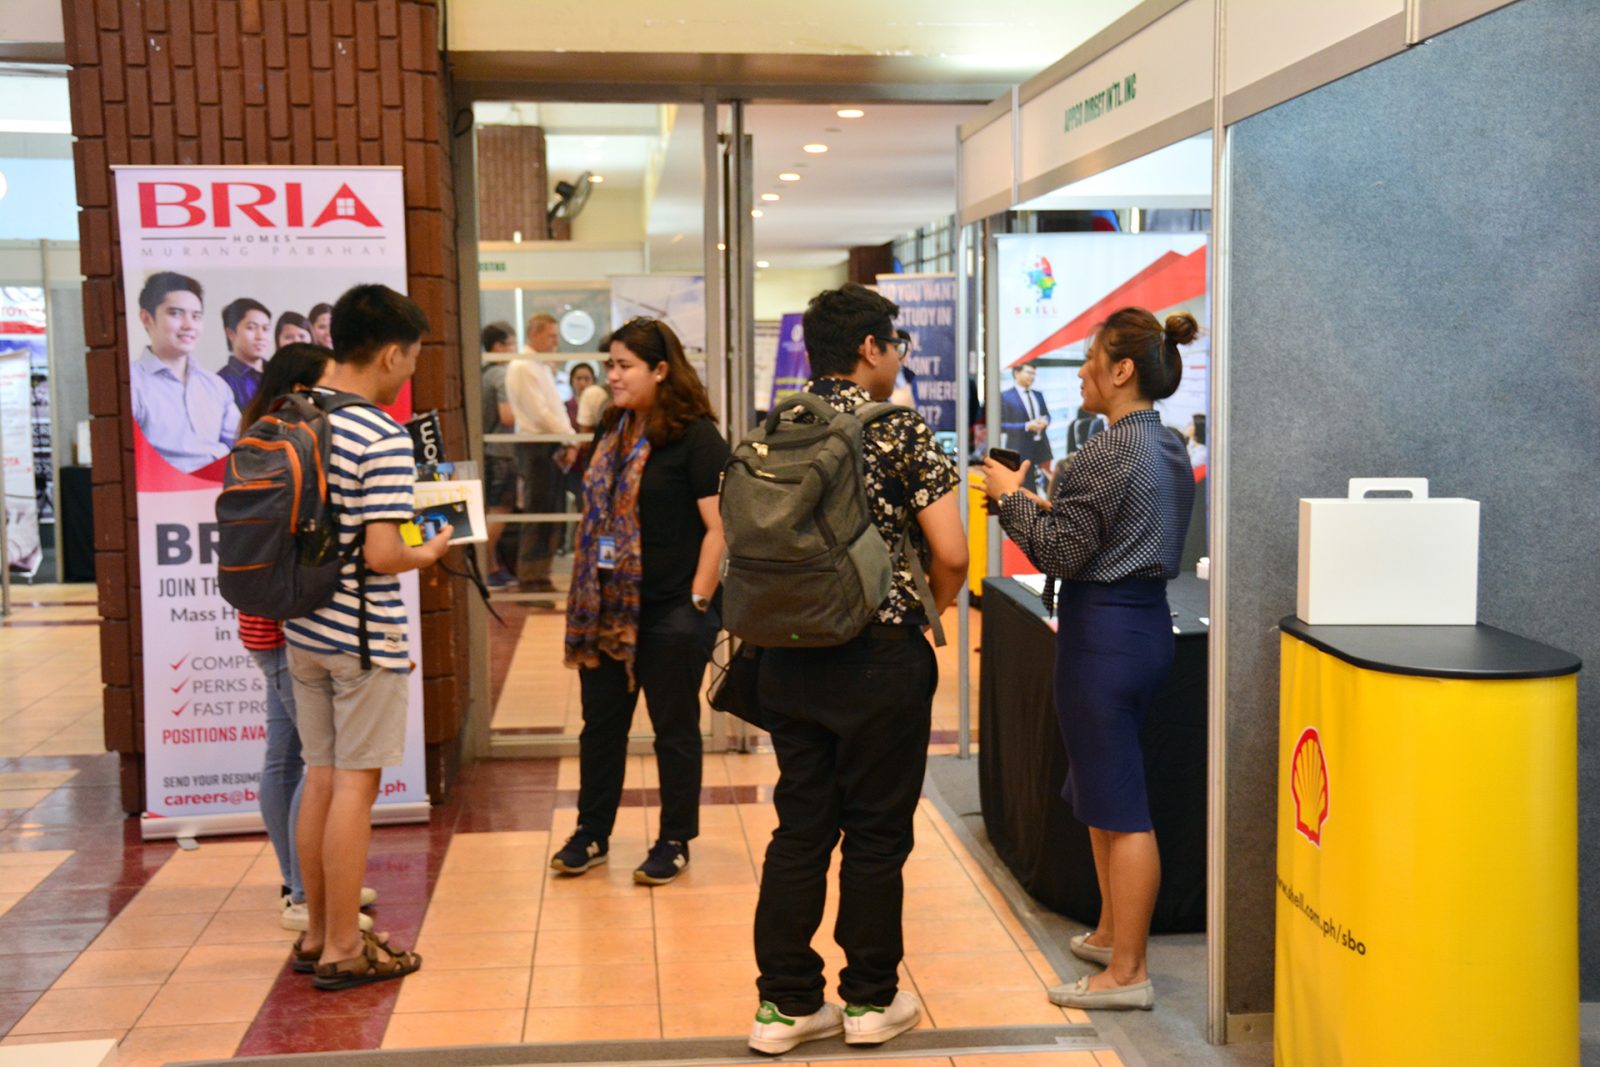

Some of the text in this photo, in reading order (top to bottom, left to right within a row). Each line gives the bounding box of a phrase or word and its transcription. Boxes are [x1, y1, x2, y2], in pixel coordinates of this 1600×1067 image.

[138, 182, 384, 229] BRIA
[233, 234, 291, 243] HOMES
[141, 245, 387, 257] MURANG PABAHAY
[158, 577, 196, 597] JOIN
[171, 606, 236, 622] Mass H
[215, 626, 231, 641] in
[193, 678, 263, 693] PERKS &
[193, 701, 235, 716] FAST
[162, 726, 237, 744] POSITIONS
[163, 776, 190, 788] SEND
[192, 774, 219, 787] YOUR
